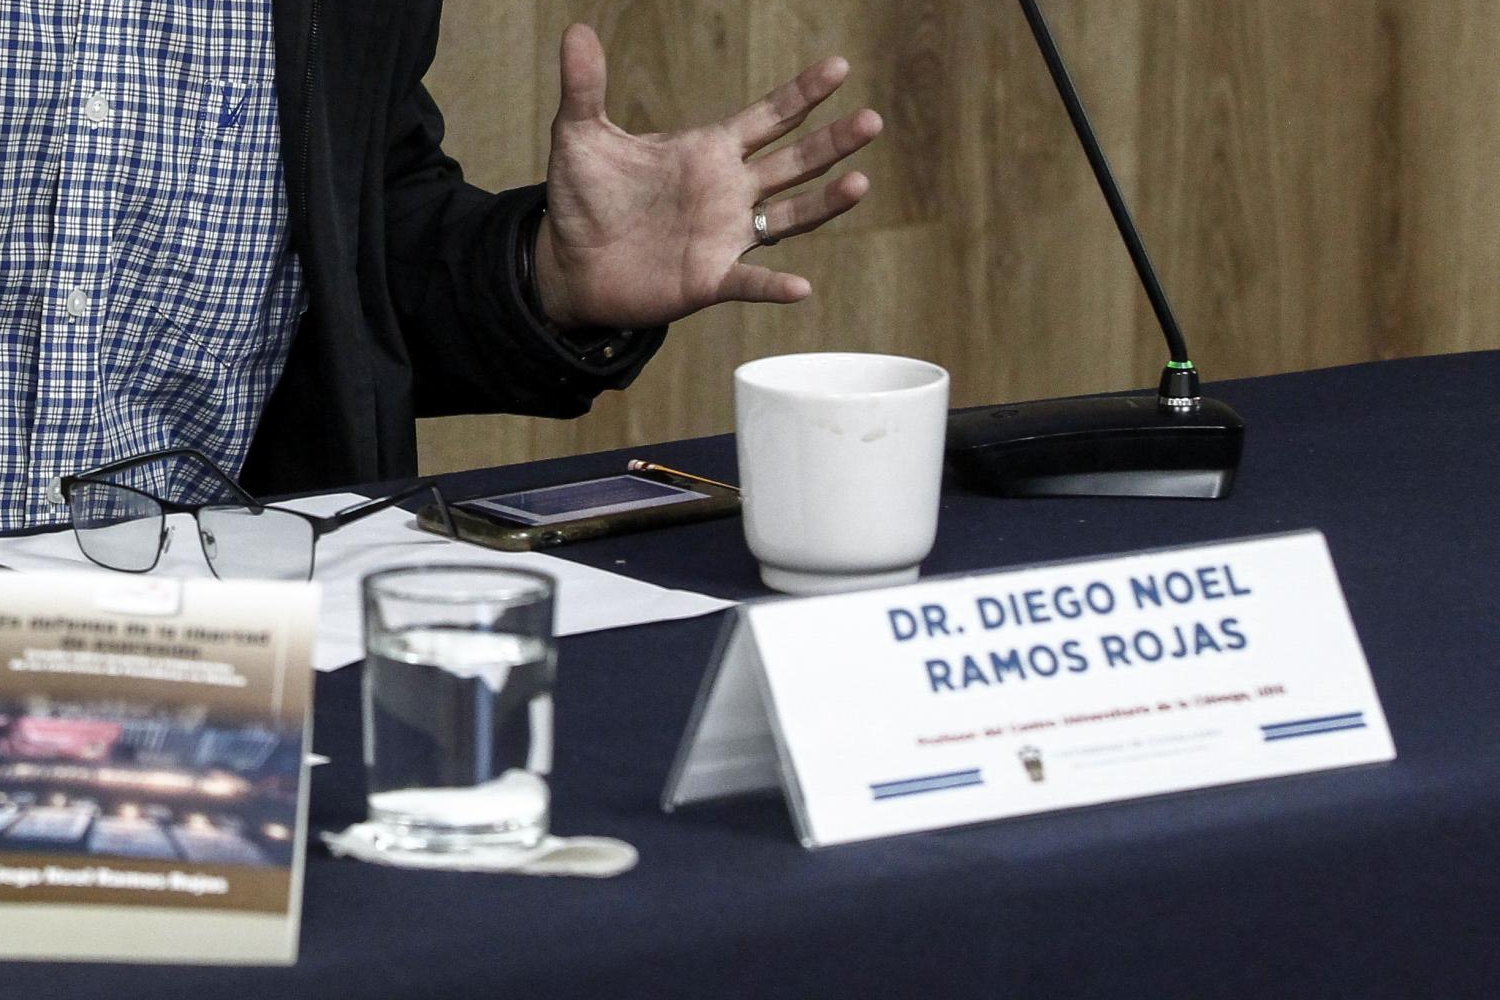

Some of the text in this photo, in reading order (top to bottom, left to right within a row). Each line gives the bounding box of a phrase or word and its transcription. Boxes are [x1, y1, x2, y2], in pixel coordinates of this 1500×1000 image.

[887, 564, 1252, 642] DR. DIEGO NOEL
[924, 617, 1248, 694] RAMOS ROJAS
